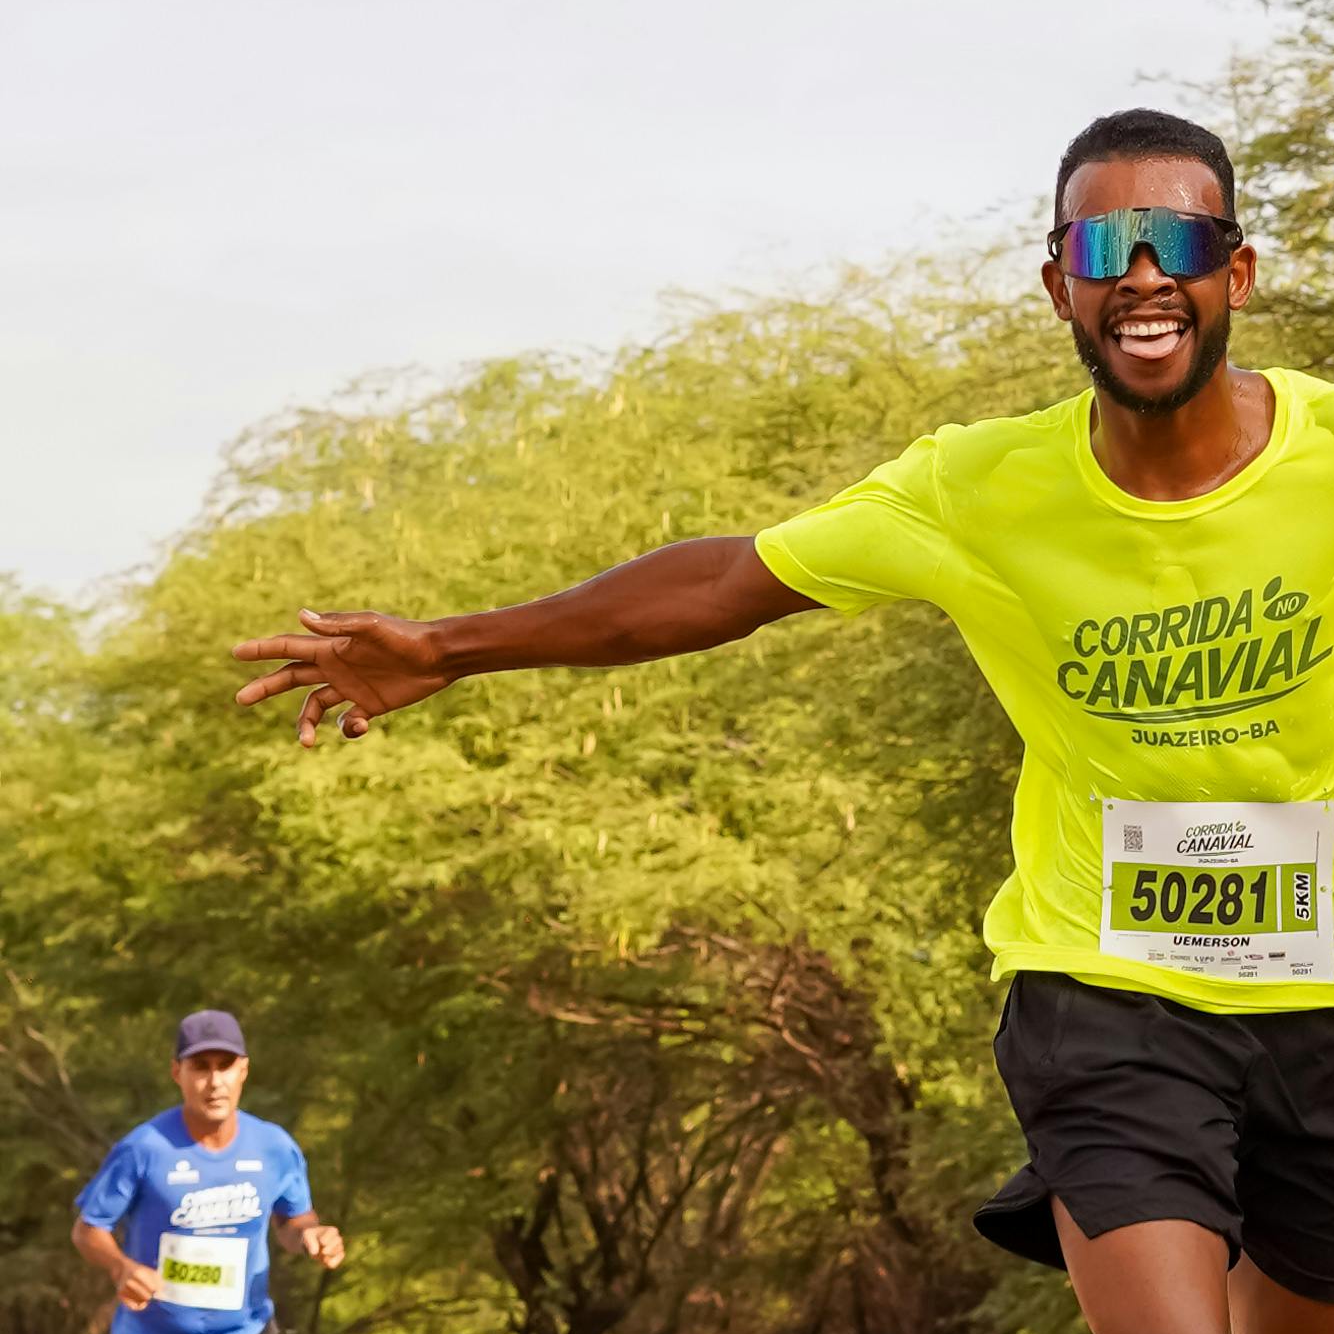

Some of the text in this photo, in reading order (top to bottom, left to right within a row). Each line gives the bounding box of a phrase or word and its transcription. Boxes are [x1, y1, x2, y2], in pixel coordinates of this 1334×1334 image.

[1073, 588, 1301, 658] CORRIDA NO
[1056, 615, 1334, 709] CANAVIAL
[1131, 719, 1280, 748] JUAZEIRO-BA
[1176, 833, 1255, 854] CANAVIAL
[1185, 822, 1233, 838] CORRIDA
[1129, 870, 1269, 926] 50281
[1294, 873, 1310, 920] 5KM
[1172, 936, 1251, 948] UEMERSON
[168, 1262, 222, 1284] 50280
